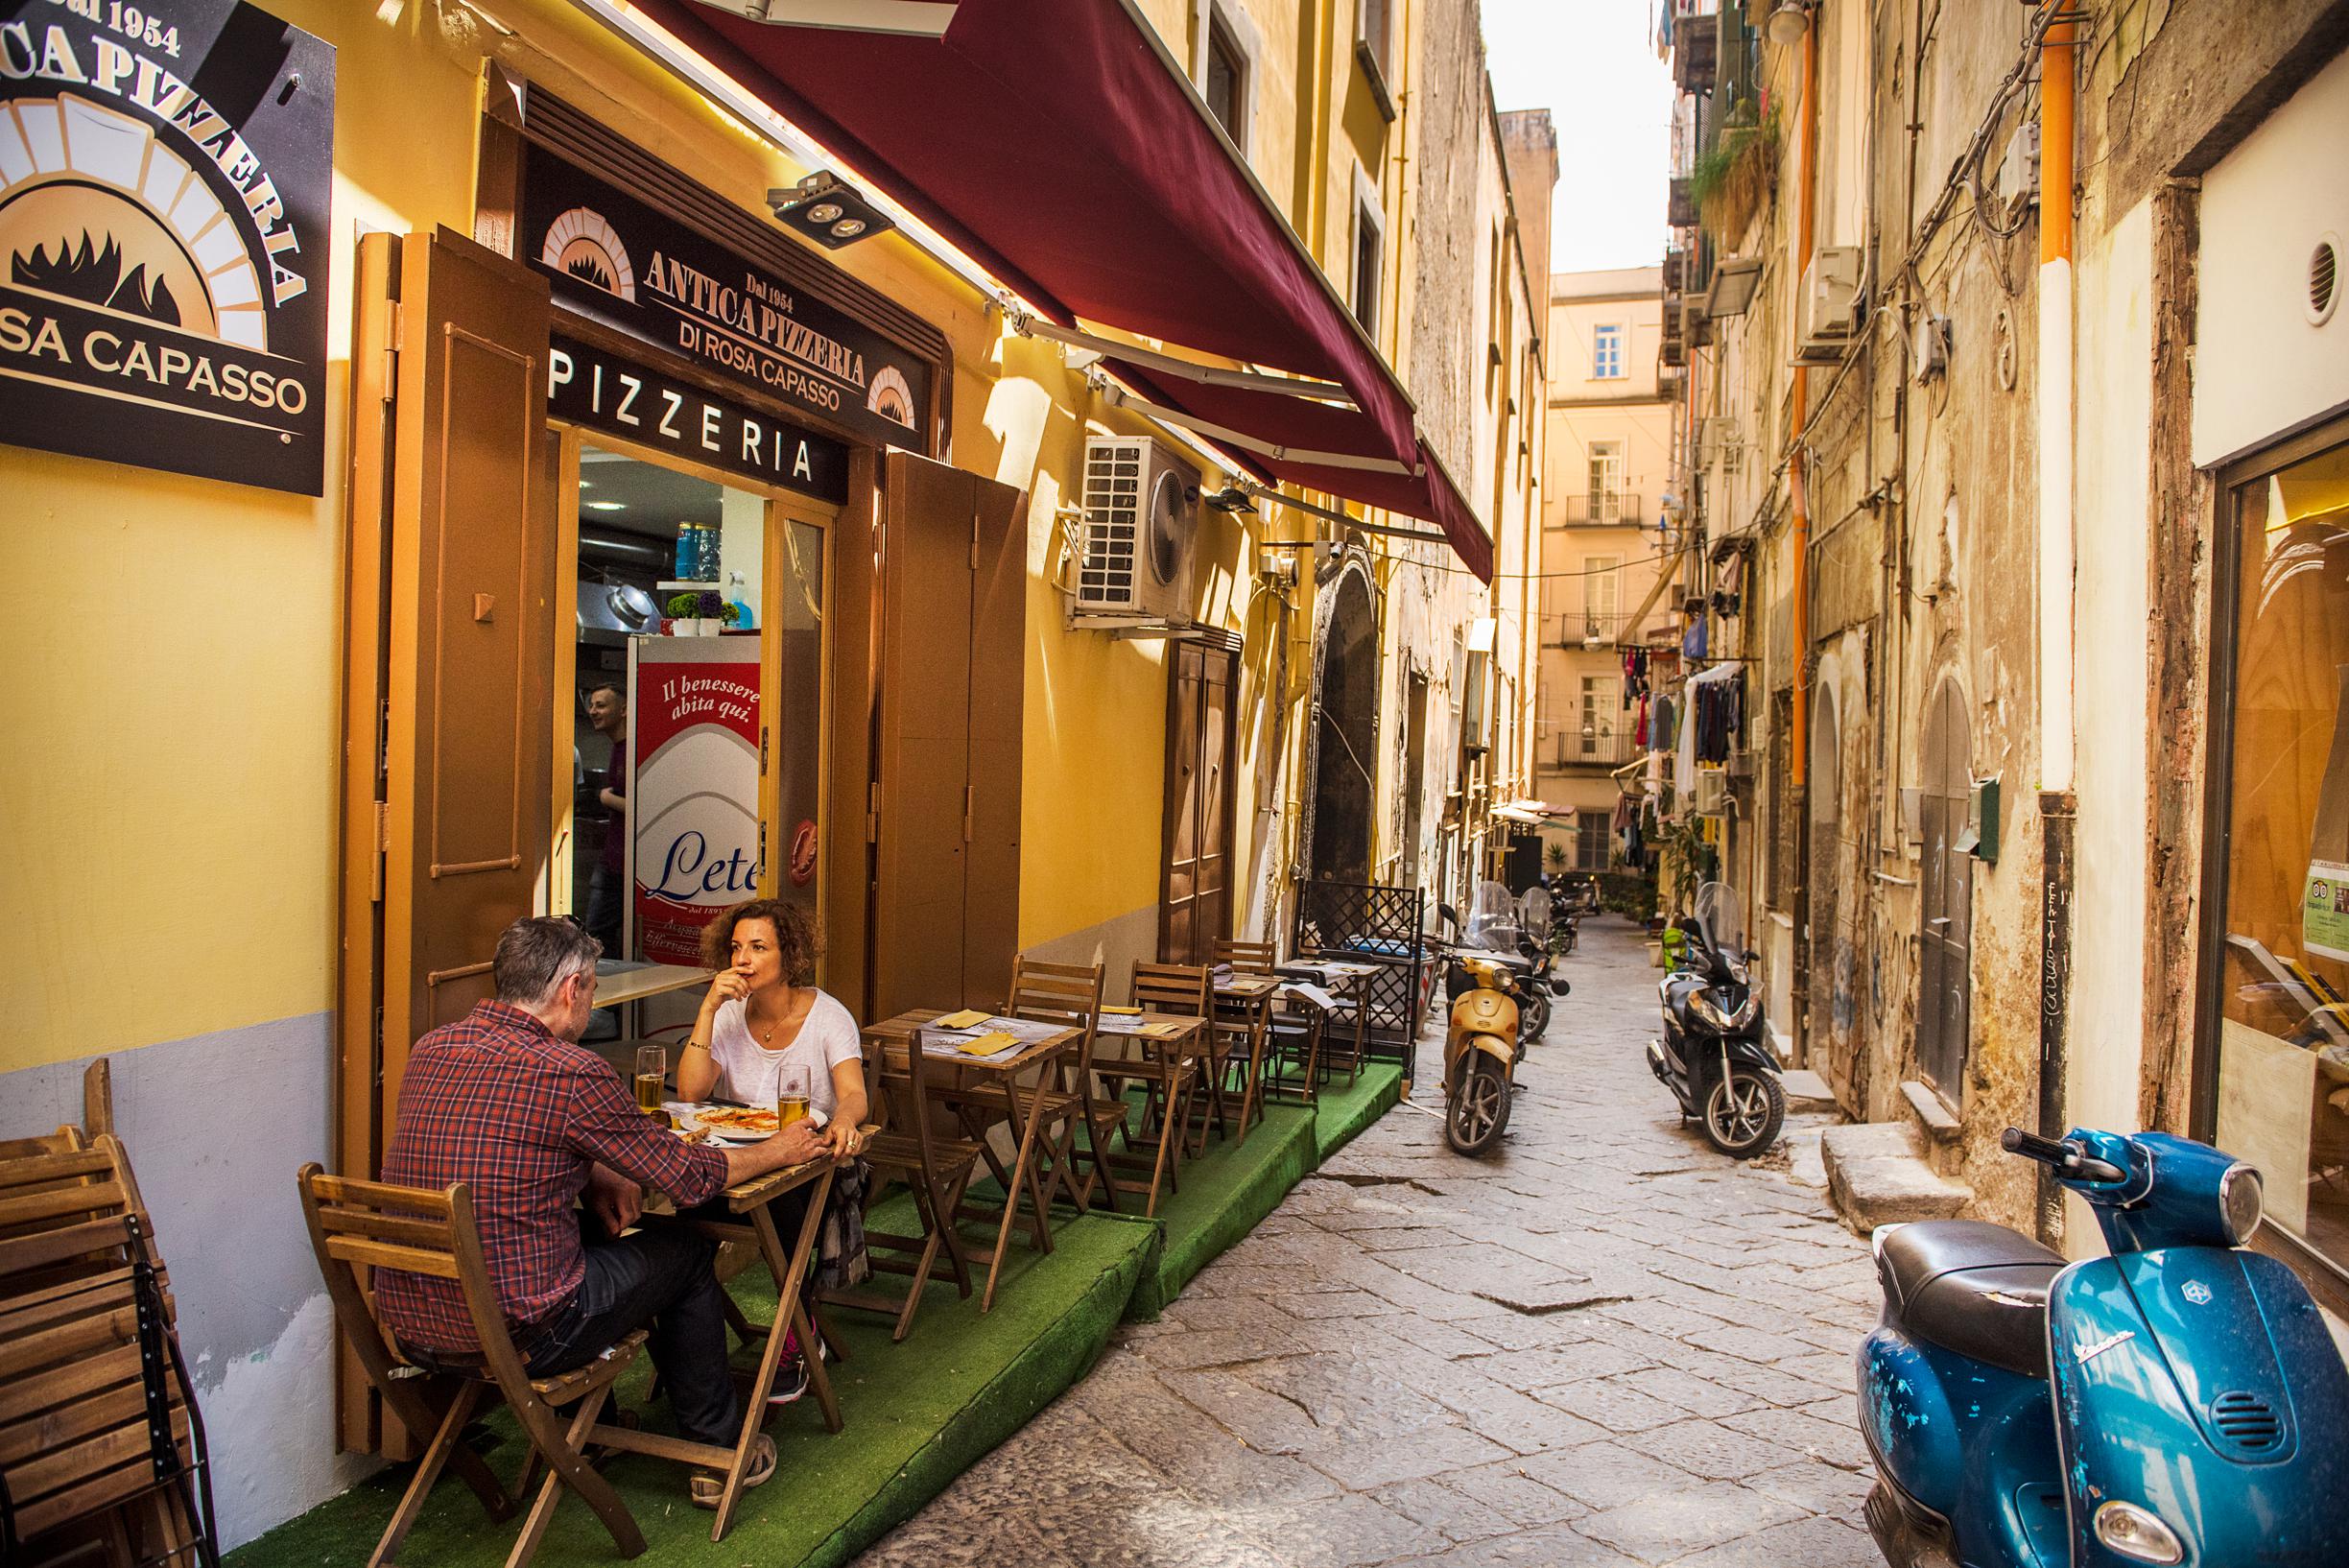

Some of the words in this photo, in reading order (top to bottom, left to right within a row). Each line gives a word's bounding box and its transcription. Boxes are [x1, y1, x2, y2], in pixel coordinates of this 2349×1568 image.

[45, 0, 103, 23] al
[107, 0, 181, 59] 1954
[91, 35, 308, 308] PIZZERIA
[642, 249, 757, 337] ANTICA
[759, 304, 866, 389] PIZZERIA
[746, 272, 768, 301] Dal
[768, 287, 795, 315] 1954
[83, 329, 308, 415] CAPASSO
[679, 320, 701, 352] DI
[704, 331, 758, 378] ROSA
[761, 359, 840, 412] CAPASSO
[548, 348, 812, 482] PIZZERIA
[661, 678, 676, 702] Il
[680, 675, 760, 703] benessere
[672, 695, 715, 721] abita
[718, 701, 751, 723] qui.
